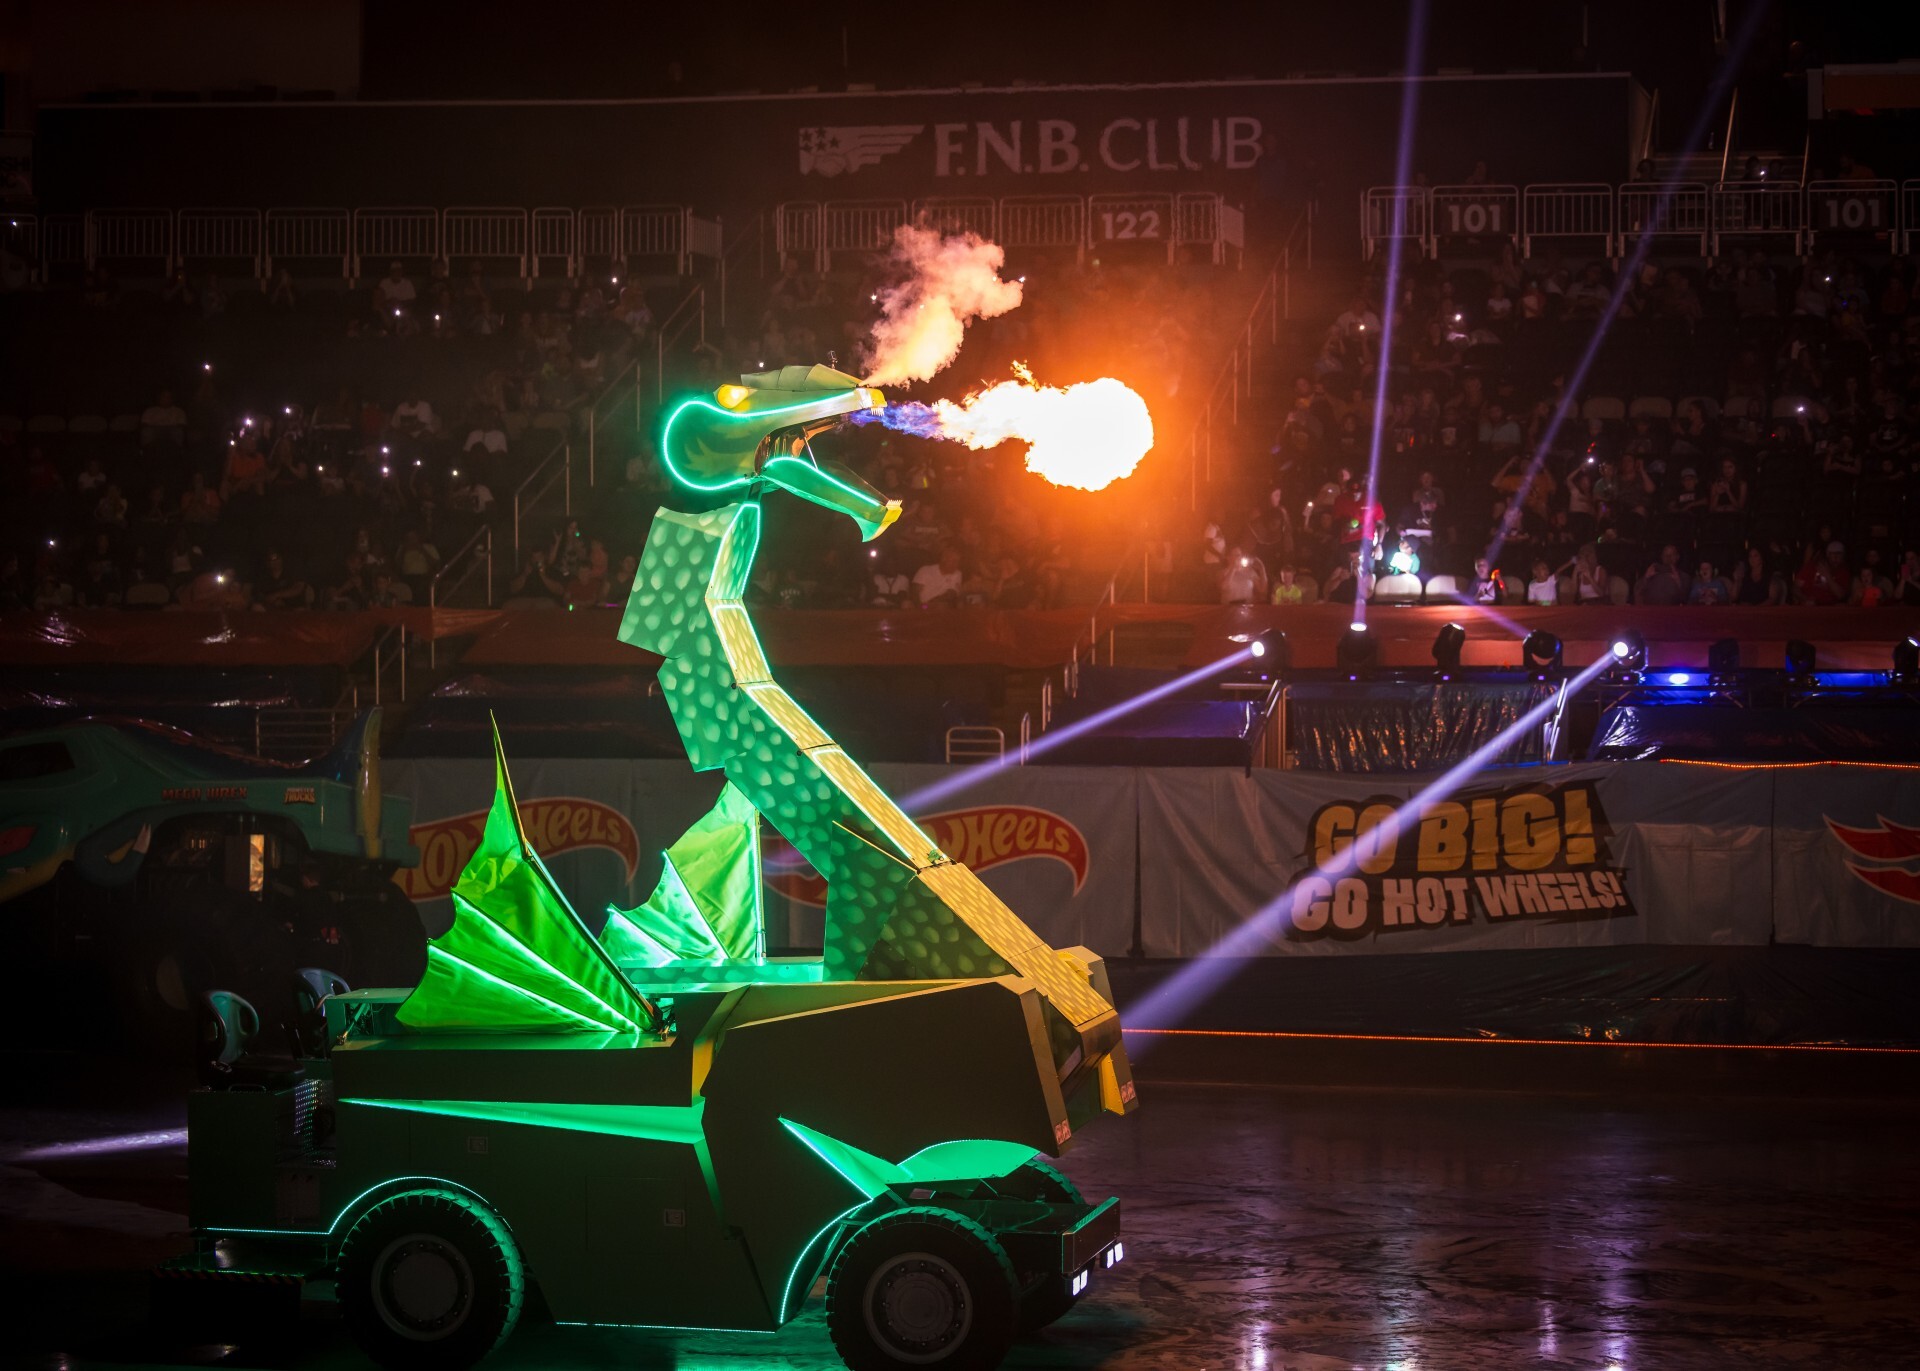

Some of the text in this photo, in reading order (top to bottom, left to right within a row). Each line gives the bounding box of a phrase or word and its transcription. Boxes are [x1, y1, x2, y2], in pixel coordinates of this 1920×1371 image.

[935, 117, 1264, 176] F.N.B. CLUB
[1102, 209, 1160, 240] 122
[1448, 203, 1501, 233] 101
[1825, 198, 1880, 229] 101
[1314, 788, 1598, 874] GO BIG!
[1291, 871, 1628, 931] GO HOT WHEELS!
